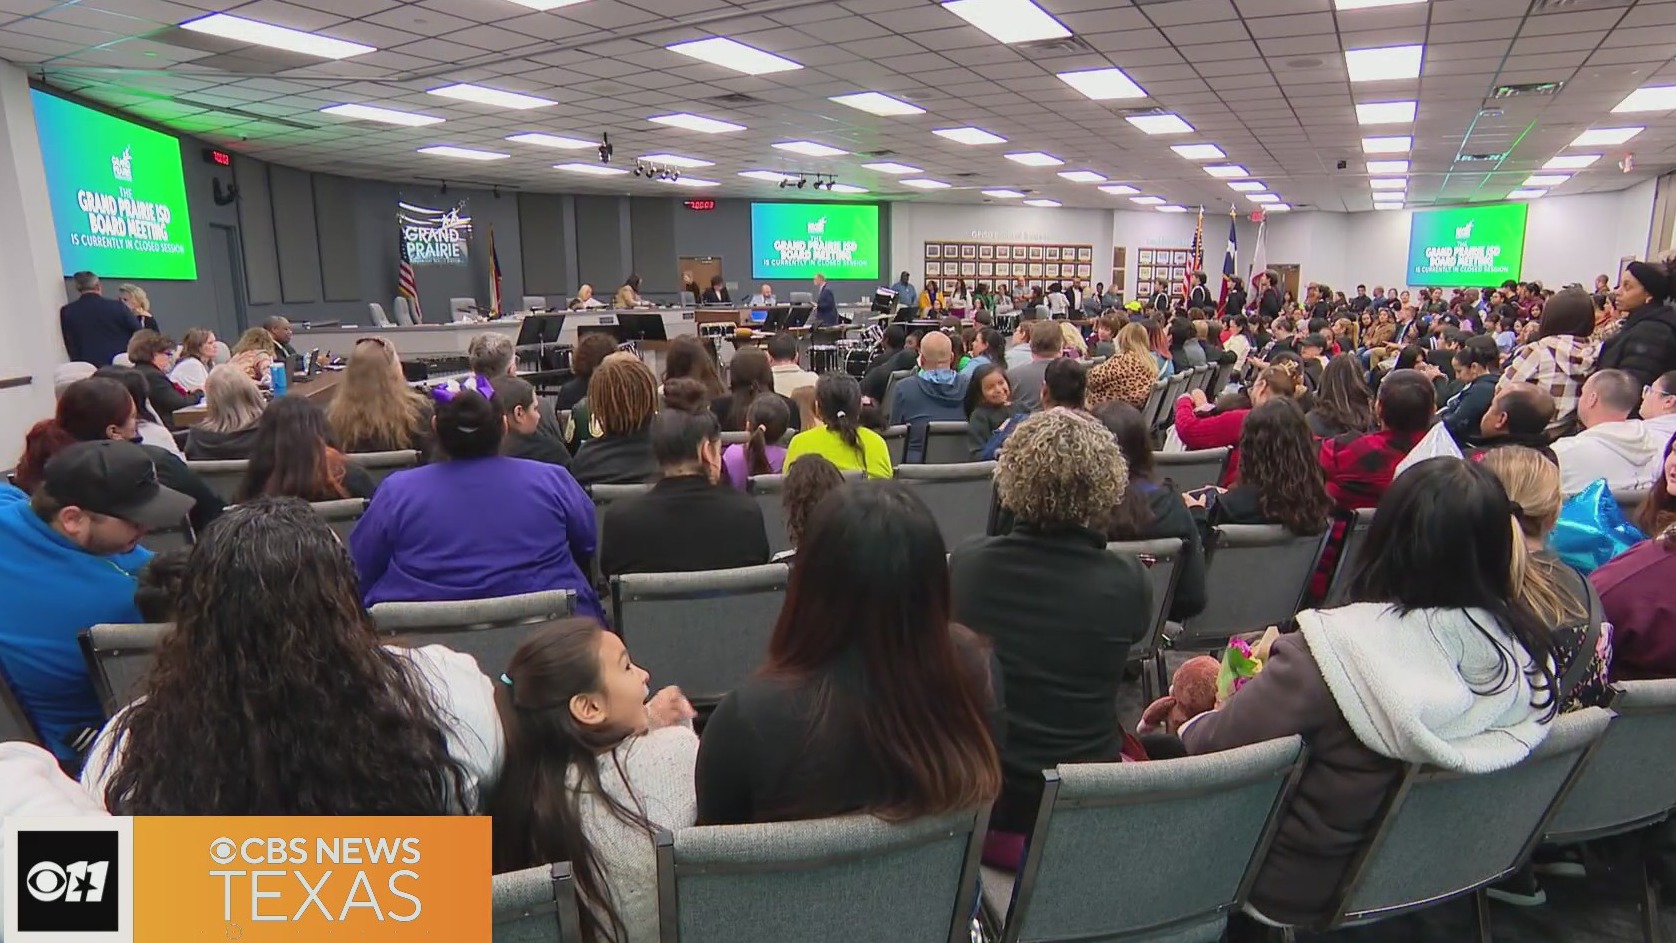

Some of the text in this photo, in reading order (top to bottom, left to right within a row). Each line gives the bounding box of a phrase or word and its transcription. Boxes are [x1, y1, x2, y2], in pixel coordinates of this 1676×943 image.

[119, 187, 132, 198] THE
[78, 189, 170, 224] GRAND PRAIRIE ISD
[89, 213, 168, 240] BOARD MEETING
[405, 227, 459, 243] GRAND
[71, 233, 184, 254] IS CURRENTLY IN CLOSED SESSION
[406, 242, 460, 258] PRAIRIE
[774, 240, 806, 251] GRAND
[780, 250, 811, 260] BOARD
[1426, 247, 1453, 257] GRAND
[1430, 256, 1456, 267] BOARD
